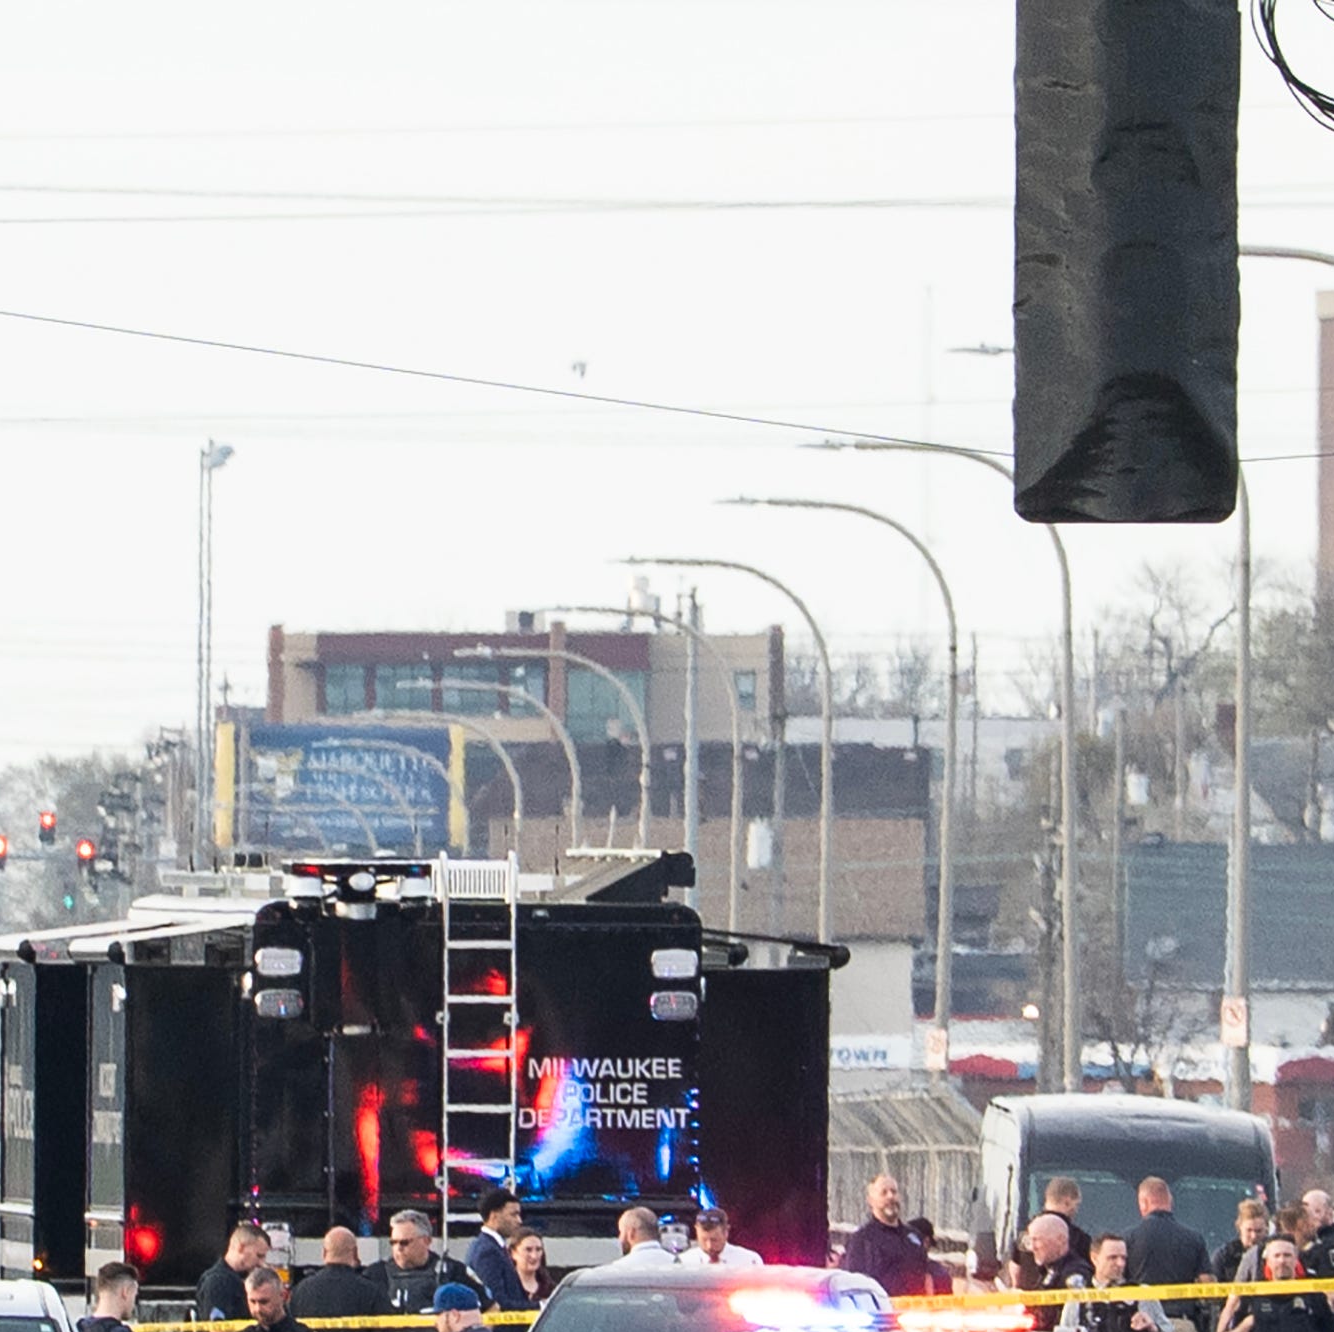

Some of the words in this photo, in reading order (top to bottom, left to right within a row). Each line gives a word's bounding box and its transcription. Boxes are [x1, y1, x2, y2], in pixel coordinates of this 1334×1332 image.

[528, 1058, 682, 1079] MILWAUKEE
[563, 1082, 648, 1104] POLICE
[518, 1107, 691, 1129] DEPARTMENT
